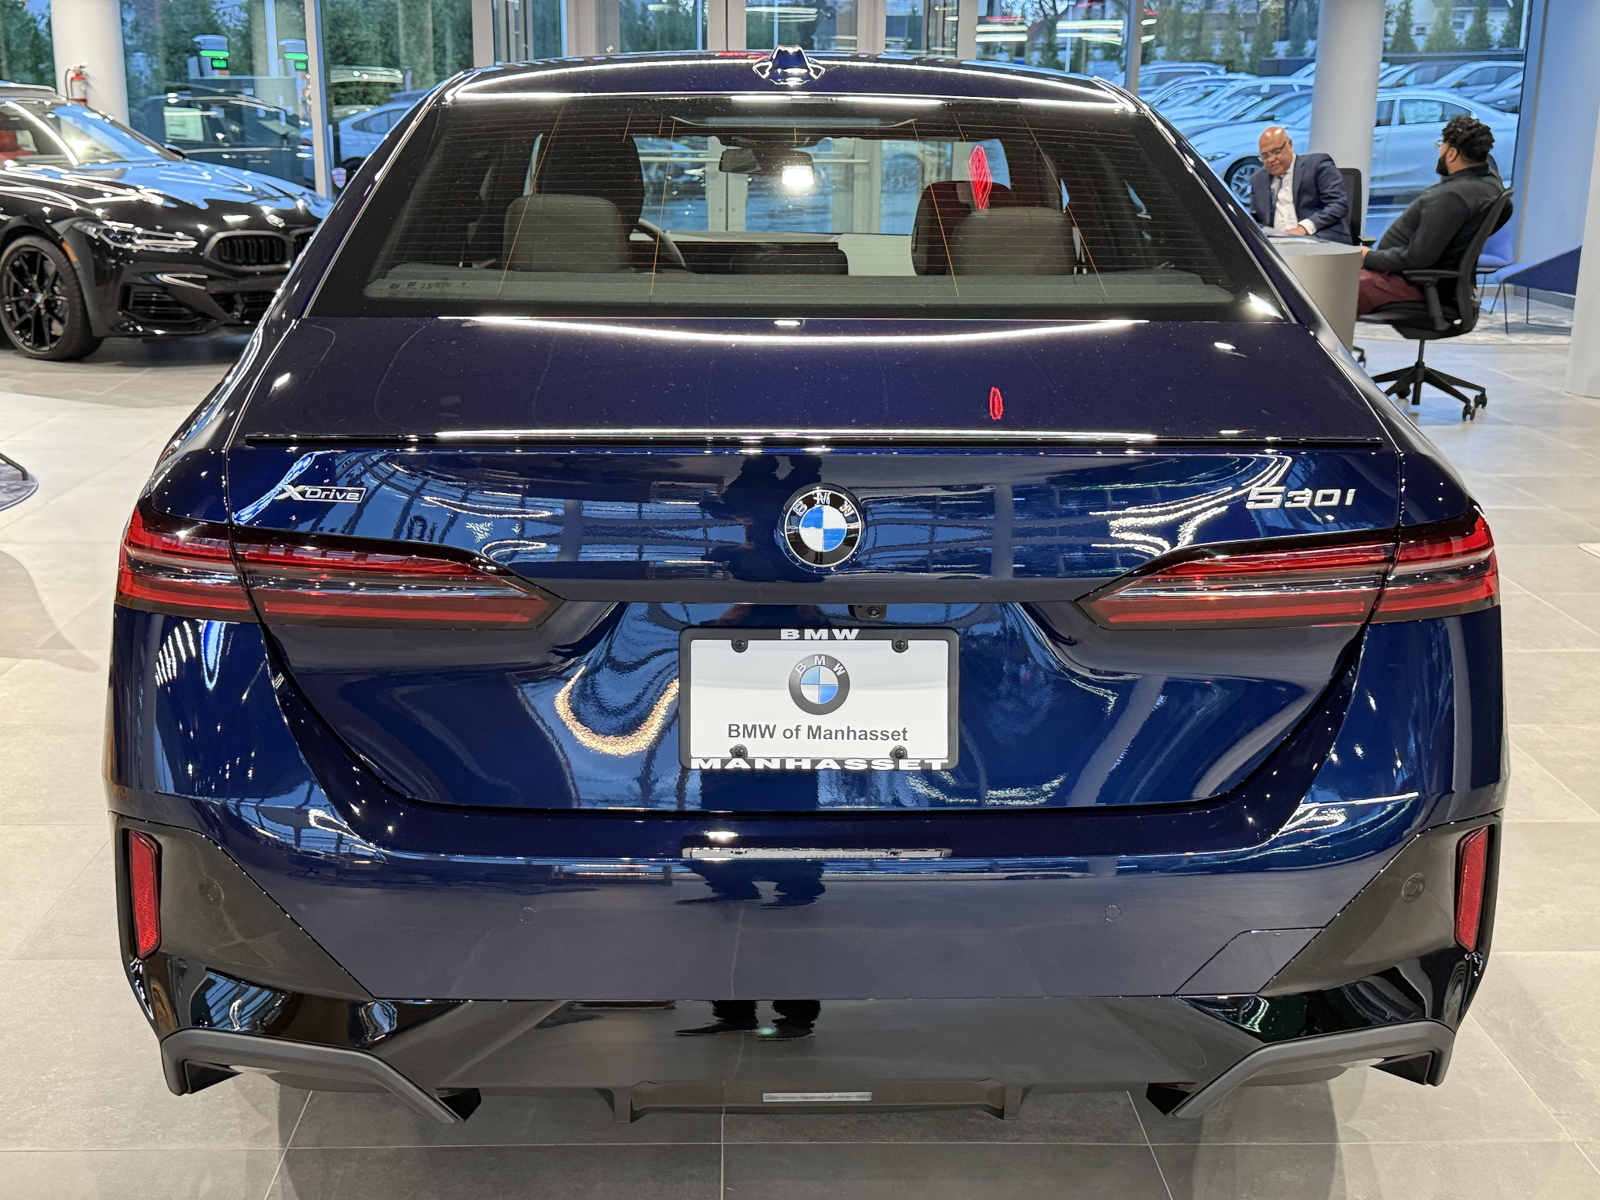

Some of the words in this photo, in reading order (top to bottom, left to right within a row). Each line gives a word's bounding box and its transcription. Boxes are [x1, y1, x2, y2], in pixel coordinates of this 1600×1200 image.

[792, 491, 855, 517] BMW
[780, 628, 860, 640] BMW
[794, 654, 847, 676] BMW
[727, 723, 777, 739] BMW
[782, 725, 802, 740] of
[806, 725, 908, 742] Manhasset
[690, 758, 949, 771] MANHASSET
